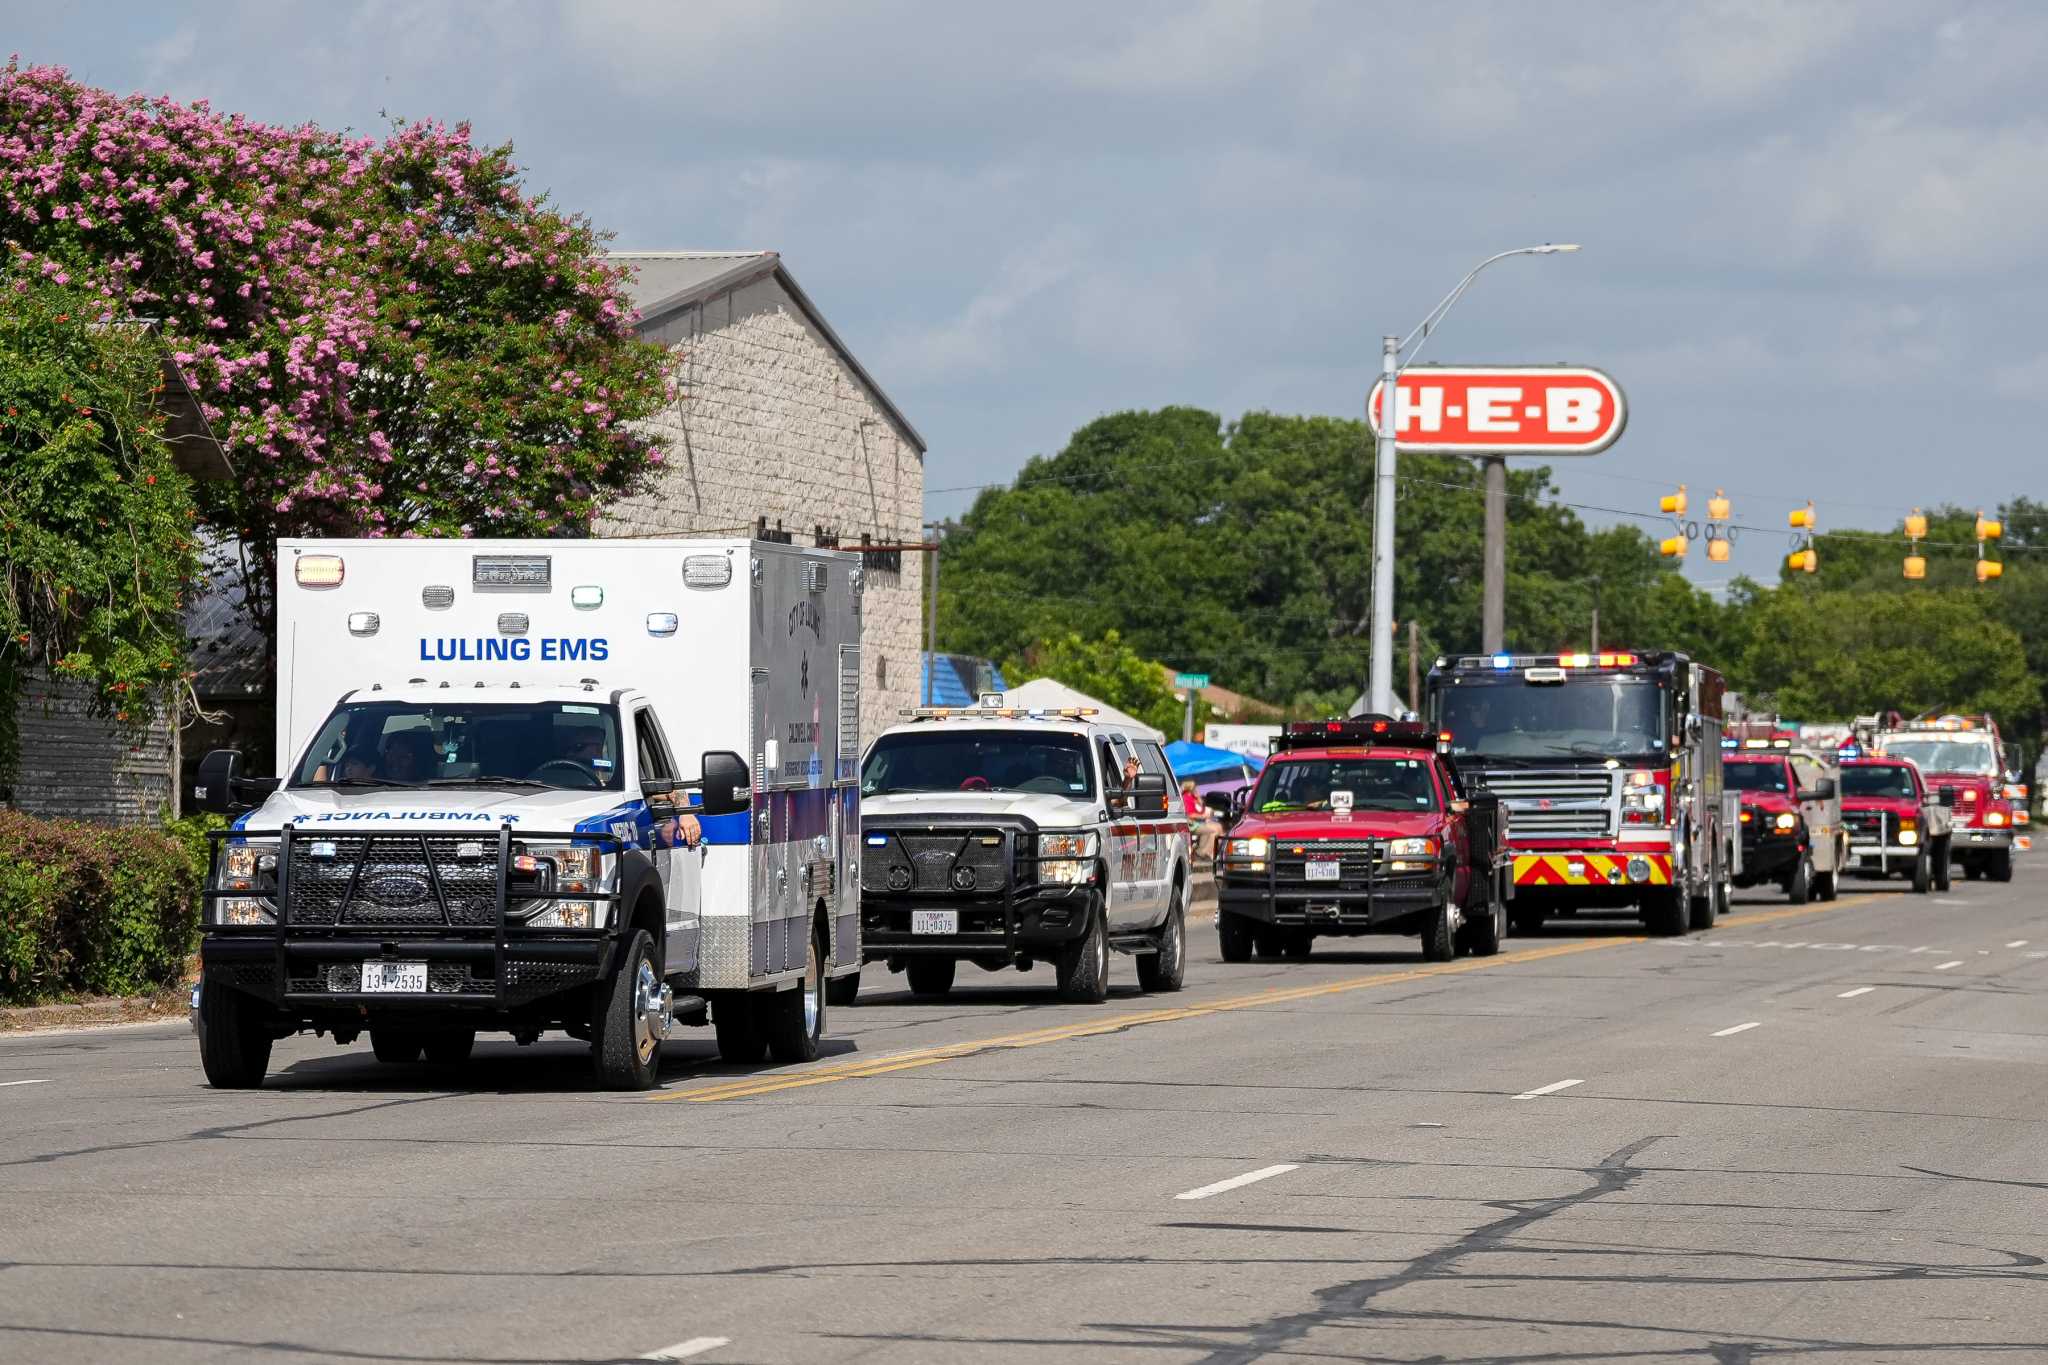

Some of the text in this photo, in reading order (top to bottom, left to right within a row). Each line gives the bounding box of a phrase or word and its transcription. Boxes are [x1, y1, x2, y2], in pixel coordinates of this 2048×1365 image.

[1394, 386, 1602, 432] H-E-B
[420, 638, 609, 661] LULING EMS
[610, 821, 631, 842] MEDIC
